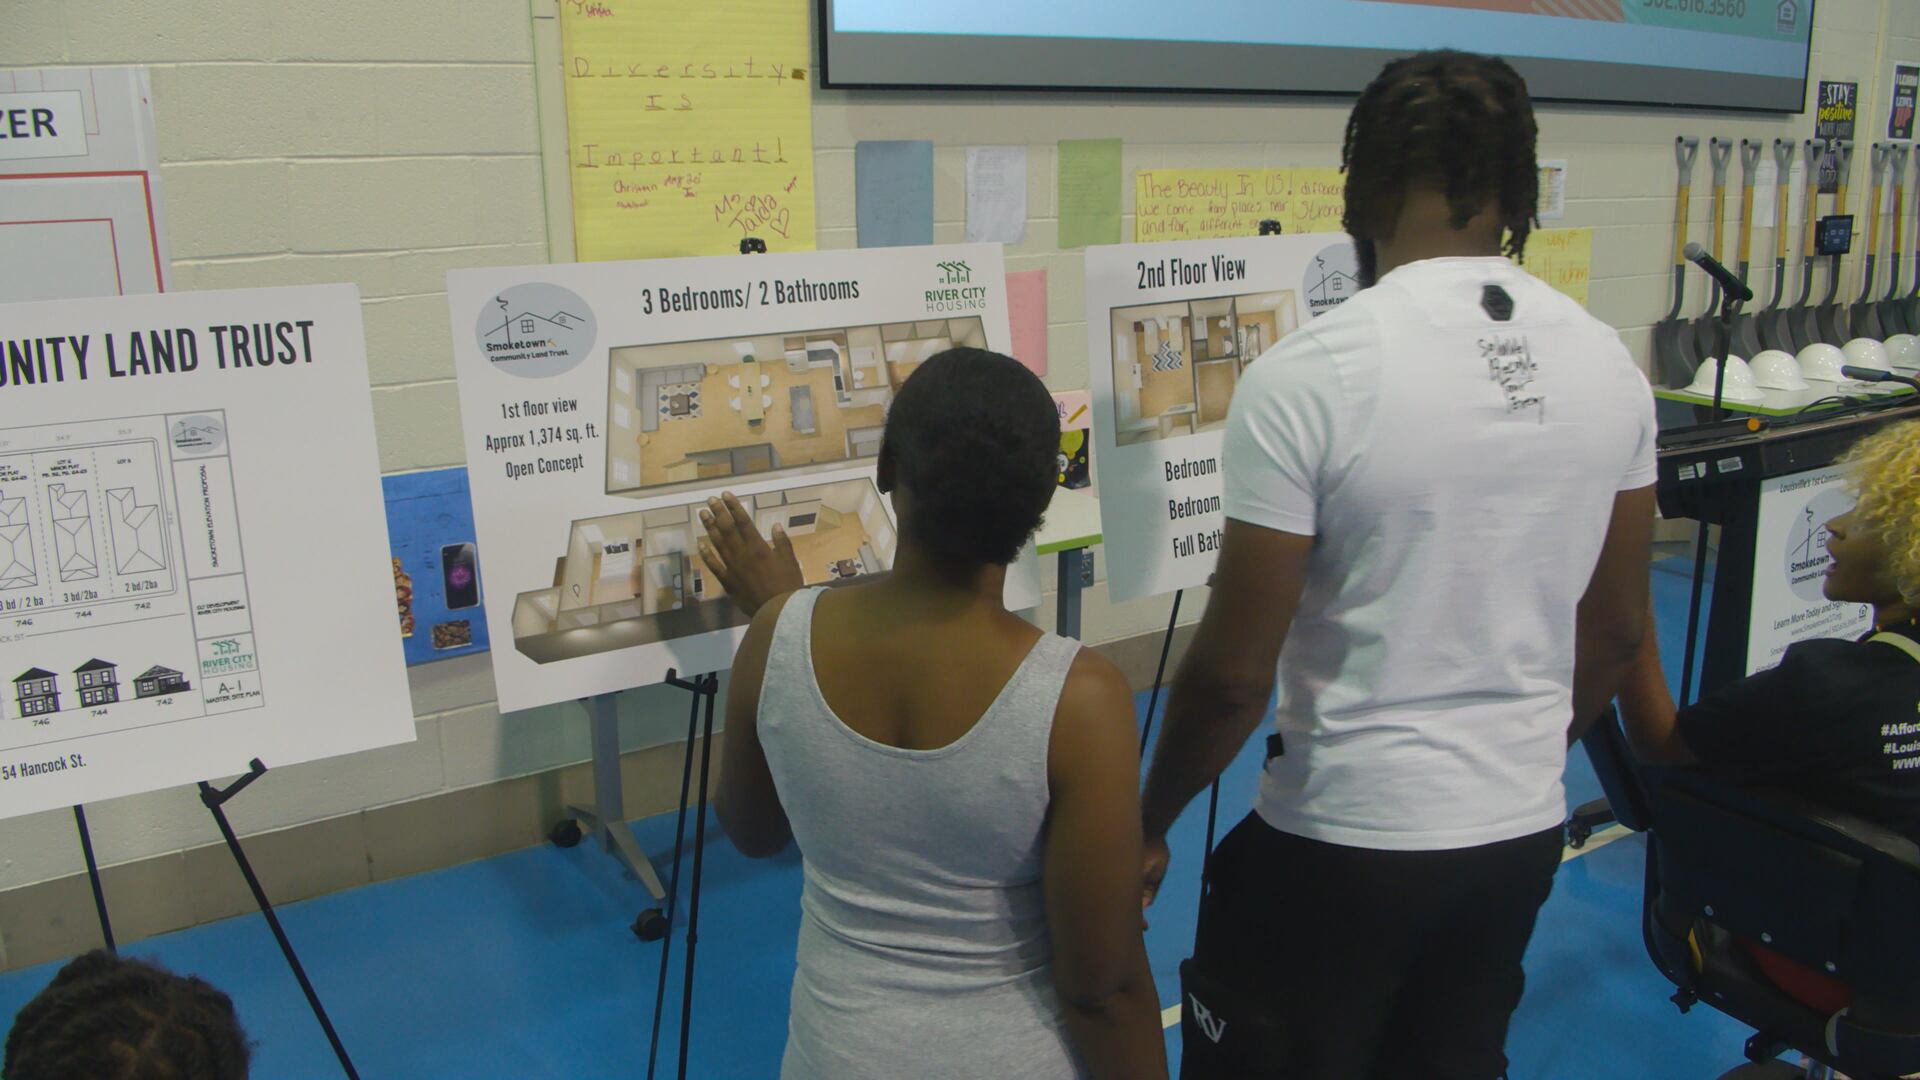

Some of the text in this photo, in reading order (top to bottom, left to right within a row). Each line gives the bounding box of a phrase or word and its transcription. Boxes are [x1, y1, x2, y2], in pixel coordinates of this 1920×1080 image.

[1827, 84, 1850, 105] STAY
[1818, 101, 1853, 127] positive
[1138, 173, 1172, 198] The
[1178, 178, 1228, 210] Beauty
[1301, 181, 1345, 196] differen
[1142, 219, 1165, 235] and
[1137, 254, 1246, 289] 2nd Floor View
[642, 278, 860, 315] 3 Bedrooms/ 2 Bathrooms
[925, 286, 987, 302] RIVER CITY
[926, 298, 987, 313] HOUSING
[105, 328, 199, 378] LAND
[208, 320, 314, 369] TRUST
[486, 340, 546, 352] Smoketown
[490, 349, 569, 362] Community Land Trust
[501, 397, 578, 419] 1st floor view
[486, 422, 600, 453] Approx 1,374 sq. ft.
[505, 454, 584, 479] Open Concept
[1165, 458, 1217, 482] Bedroom
[1169, 496, 1221, 520] Bedroom
[1173, 534, 1195, 558] Full
[1791, 555, 1830, 573] Smoketown
[125, 582, 131, 593] 2
[6, 599, 16, 610] bd
[26, 597, 31, 608] 2
[34, 596, 44, 606] ba
[64, 592, 69, 603] 3
[75, 610, 92, 618] 744
[135, 602, 151, 610] 742
[16, 618, 33, 627] 746
[1774, 619, 1790, 631] Learn
[1791, 613, 1806, 625] More
[1805, 606, 1821, 620] Today
[202, 653, 253, 668] RIVER CITY
[203, 661, 254, 675] HOUSING
[155, 697, 173, 706] 742
[90, 708, 108, 717] 744
[32, 718, 50, 727] 746
[20, 756, 68, 777] Hancock
[70, 753, 87, 768] St.
